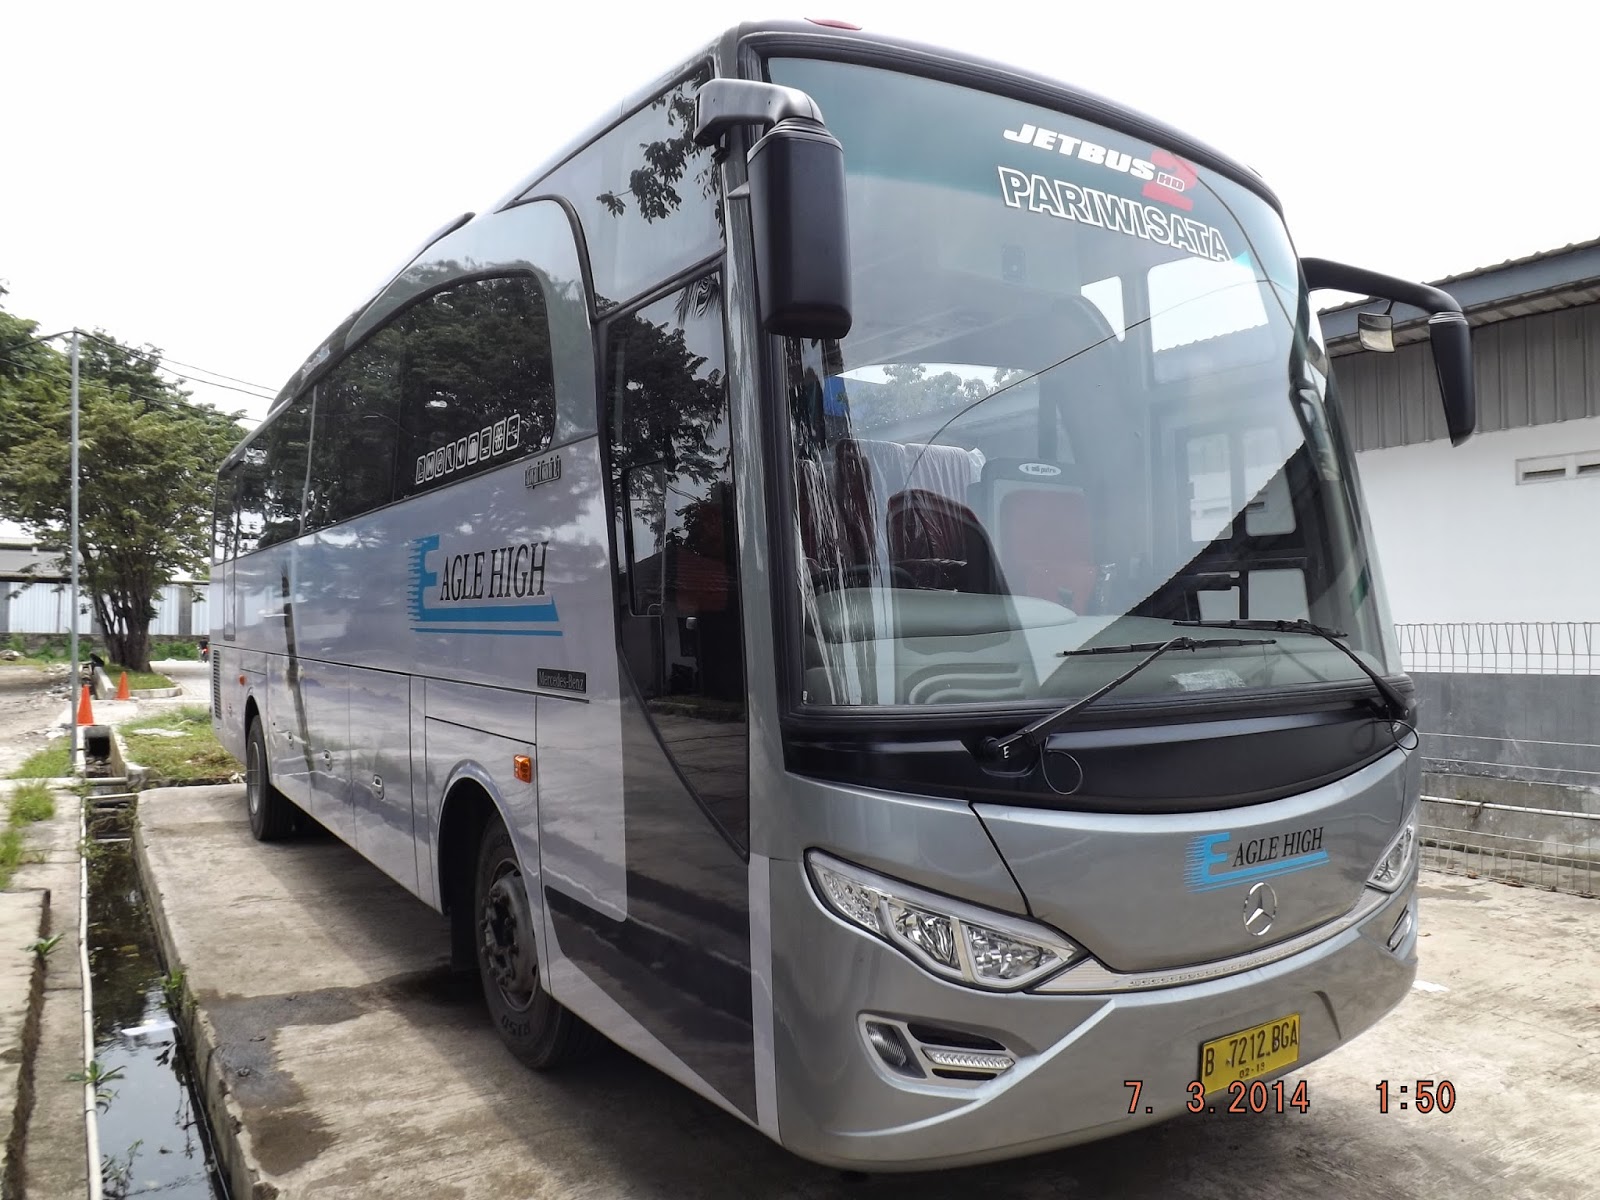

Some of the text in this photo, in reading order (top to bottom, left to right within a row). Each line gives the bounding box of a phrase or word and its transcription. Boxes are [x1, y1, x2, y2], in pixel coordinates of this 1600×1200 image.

[1002, 123, 1199, 212] JETBUS 2 HD
[997, 165, 1233, 263] PARIWISATA
[487, 540, 549, 598] HIGH
[538, 671, 584, 691] Mercedes-Benz
[1282, 826, 1324, 858] HIGH
[1204, 1019, 1298, 1077] B 7212 BGA
